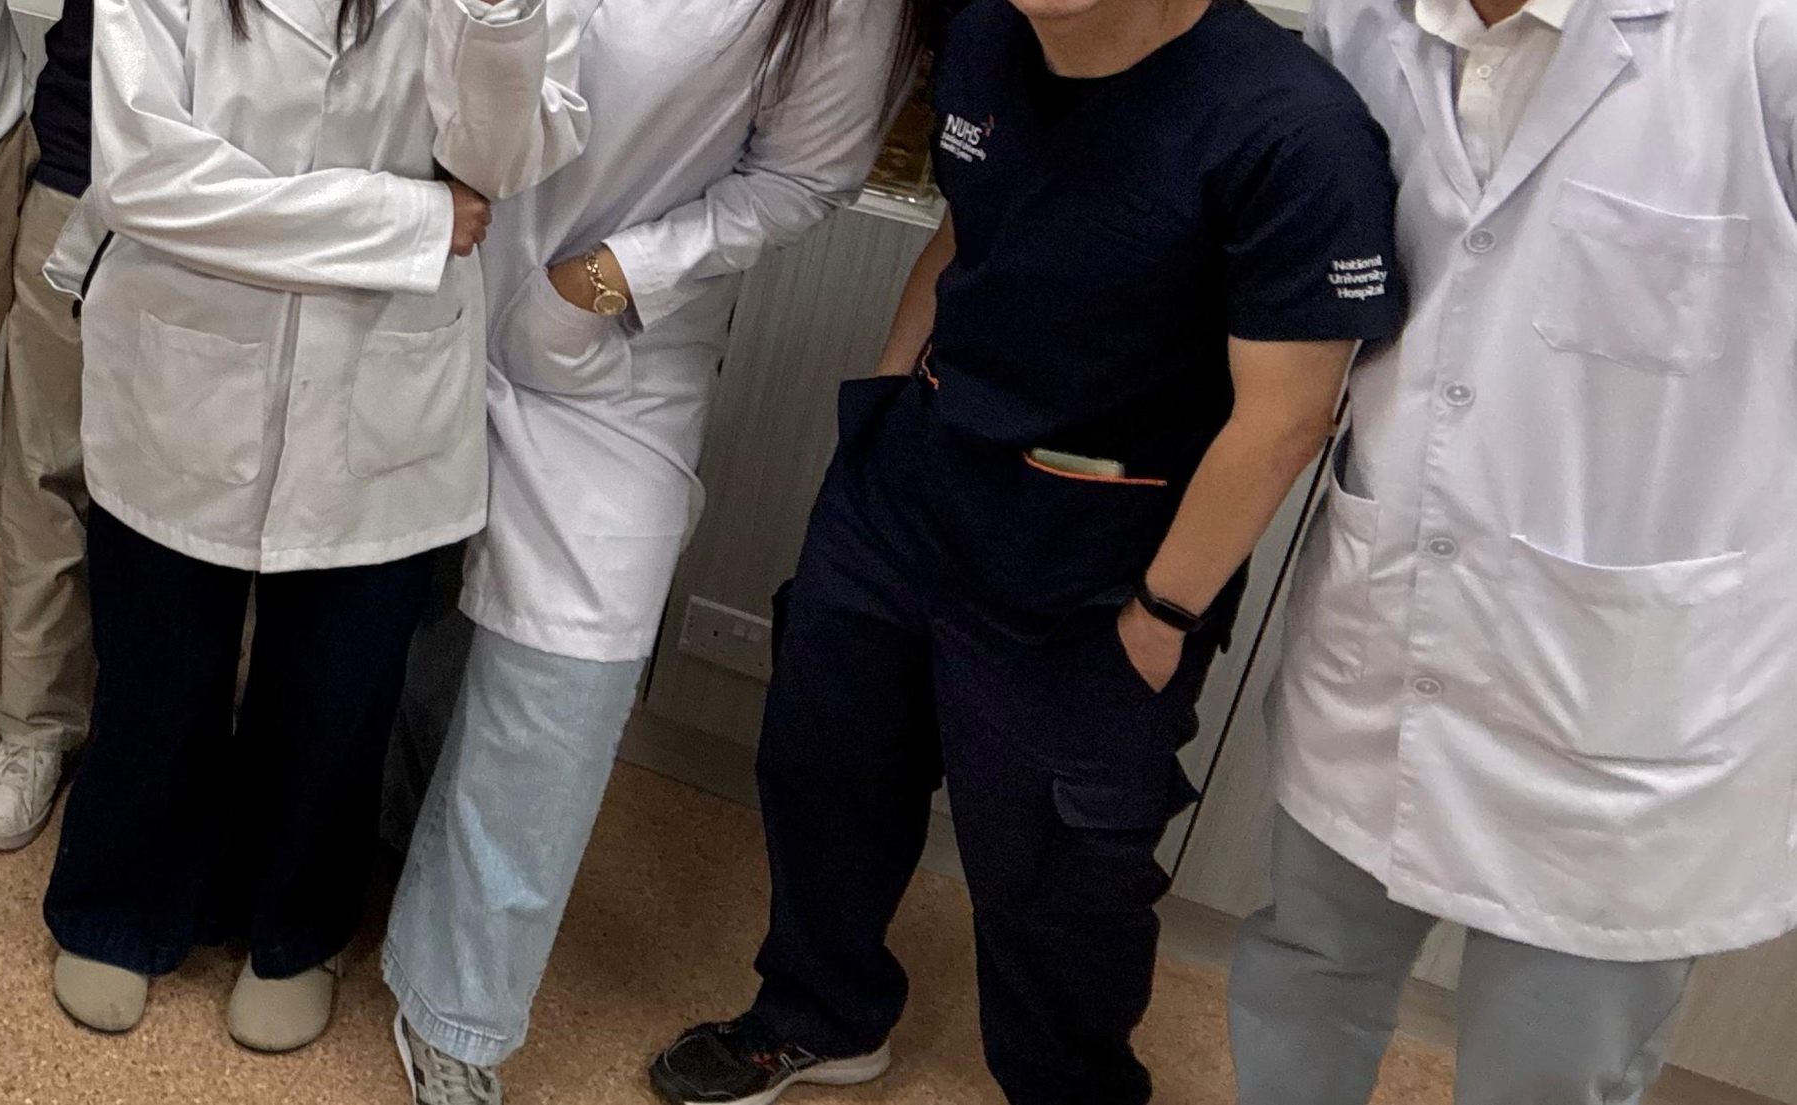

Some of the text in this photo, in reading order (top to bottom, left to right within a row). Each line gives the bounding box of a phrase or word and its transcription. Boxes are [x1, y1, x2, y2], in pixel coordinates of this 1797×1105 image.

[944, 113, 983, 145] NUHS
[1332, 254, 1383, 271] National
[1328, 270, 1388, 284] University
[1336, 283, 1385, 301] Hospital
